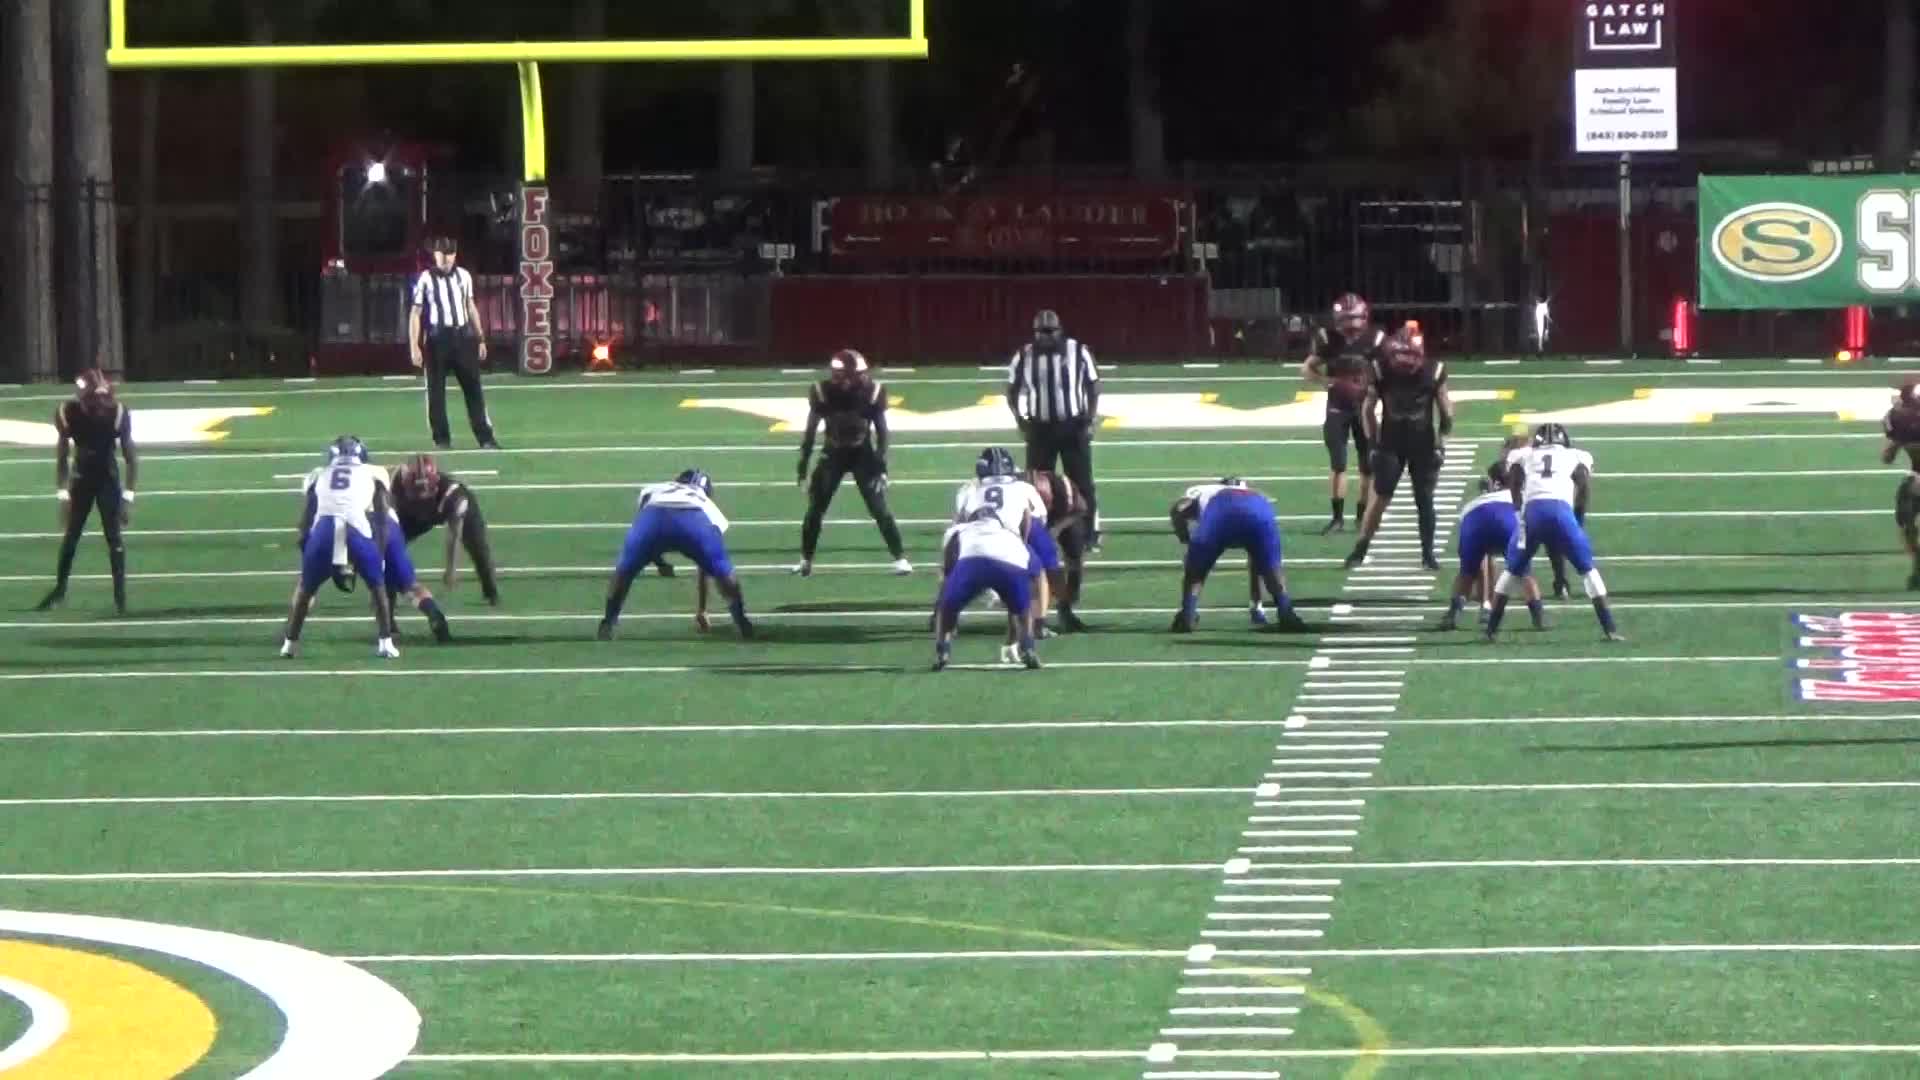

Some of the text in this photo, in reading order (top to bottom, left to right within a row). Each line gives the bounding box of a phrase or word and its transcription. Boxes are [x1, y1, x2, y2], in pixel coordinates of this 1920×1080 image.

[1586, 4, 1664, 16] GATCH
[1604, 23, 1648, 35] LAW
[1857, 188, 1920, 294] S
[520, 186, 553, 373] FOXES
[1538, 453, 1559, 479] 1
[329, 467, 352, 491] 6
[984, 486, 1005, 510] 9
